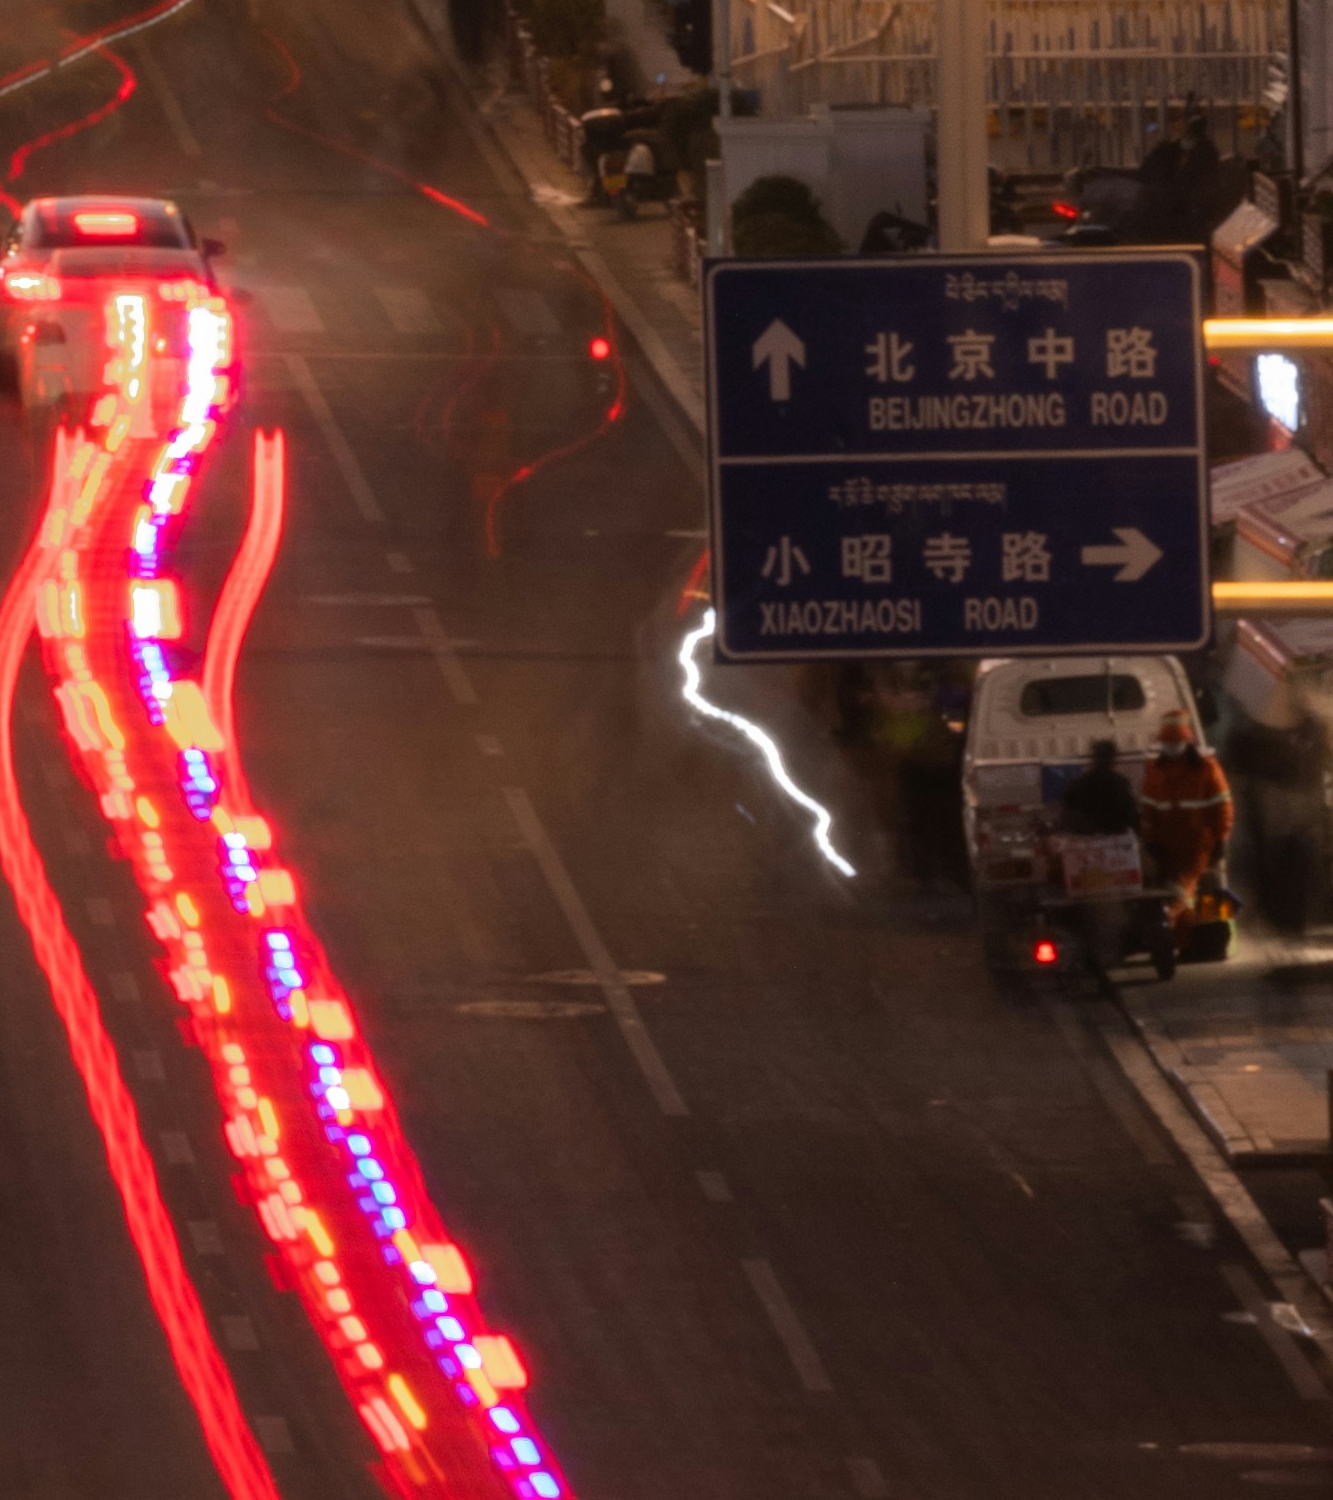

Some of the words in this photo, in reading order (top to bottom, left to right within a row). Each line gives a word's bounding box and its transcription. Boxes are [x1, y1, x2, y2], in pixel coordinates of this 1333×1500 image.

[864, 326, 1159, 382] 北京中路
[868, 391, 1066, 431] BEIJINGZHONG
[1090, 390, 1168, 427] ROAD
[760, 530, 1053, 587] 小昭寺路
[759, 598, 922, 636] XIAOZHAOSI
[964, 596, 1039, 631] ROAD
